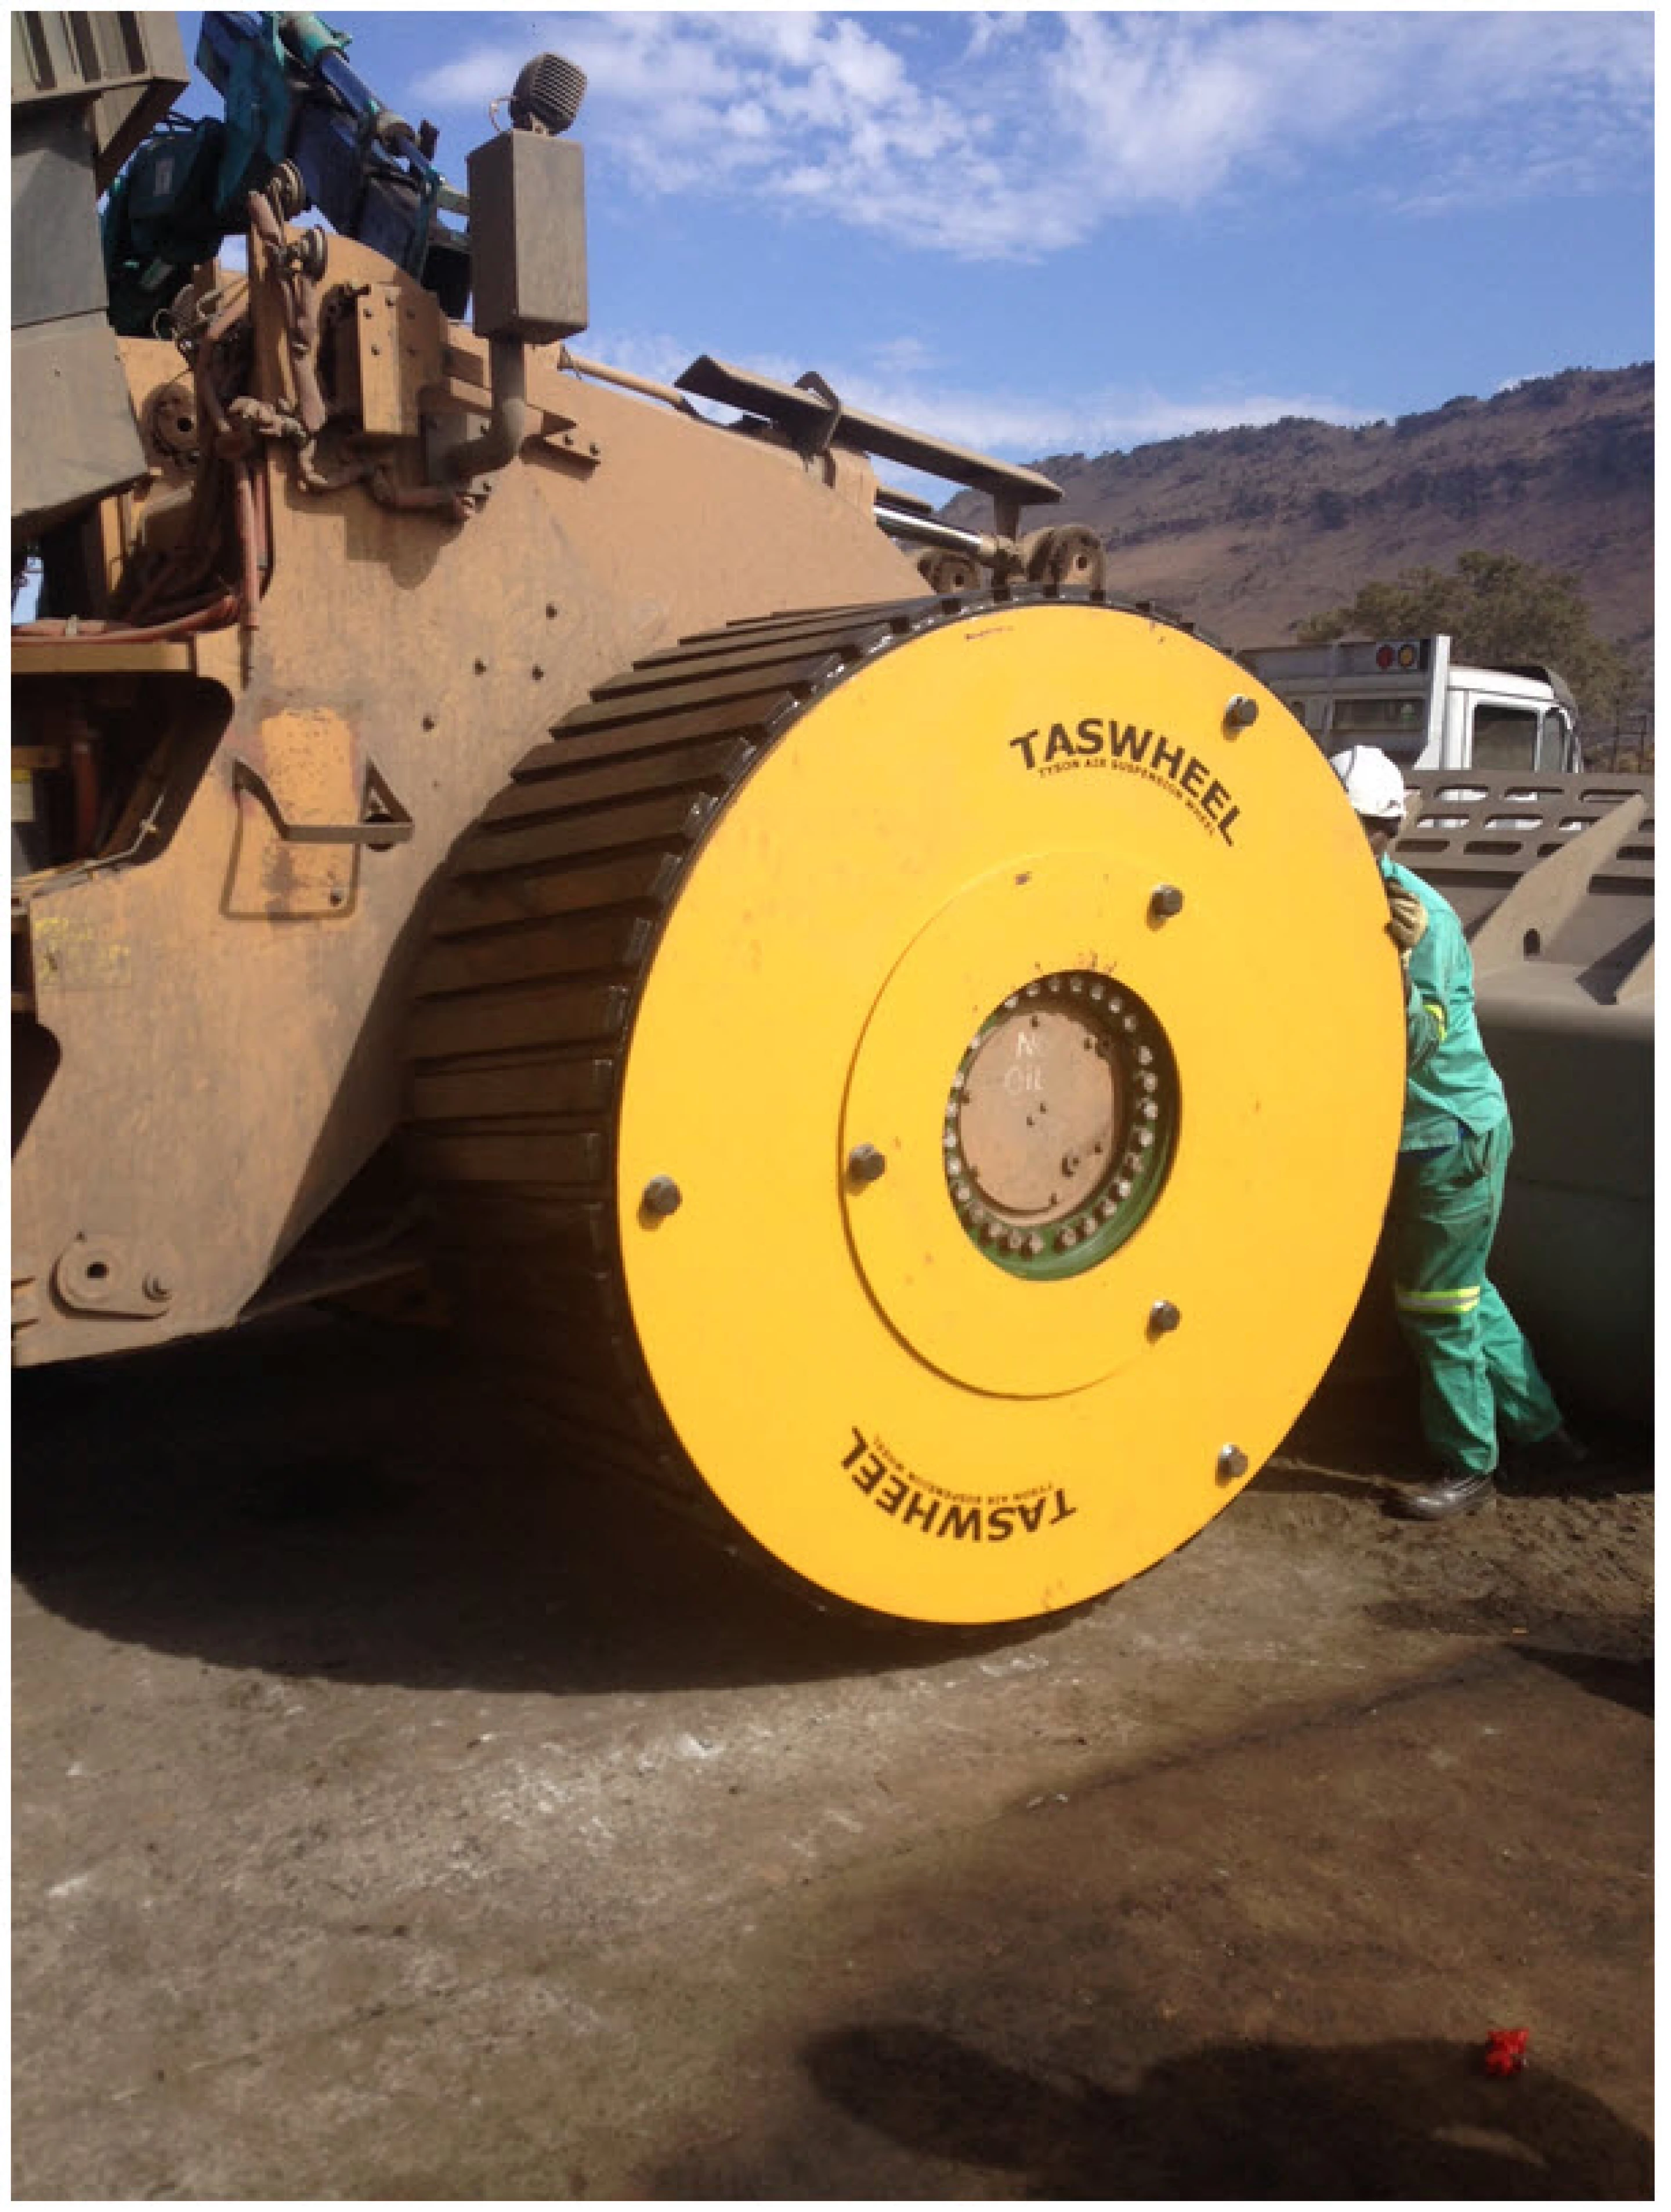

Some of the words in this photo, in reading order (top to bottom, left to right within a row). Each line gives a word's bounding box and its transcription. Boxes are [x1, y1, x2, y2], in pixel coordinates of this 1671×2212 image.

[1009, 718, 1240, 847] TASWHEEL
[1038, 759, 1079, 778] TYSON
[1084, 758, 1106, 768] AIR
[841, 1425, 1078, 1542] TASWHEEL
